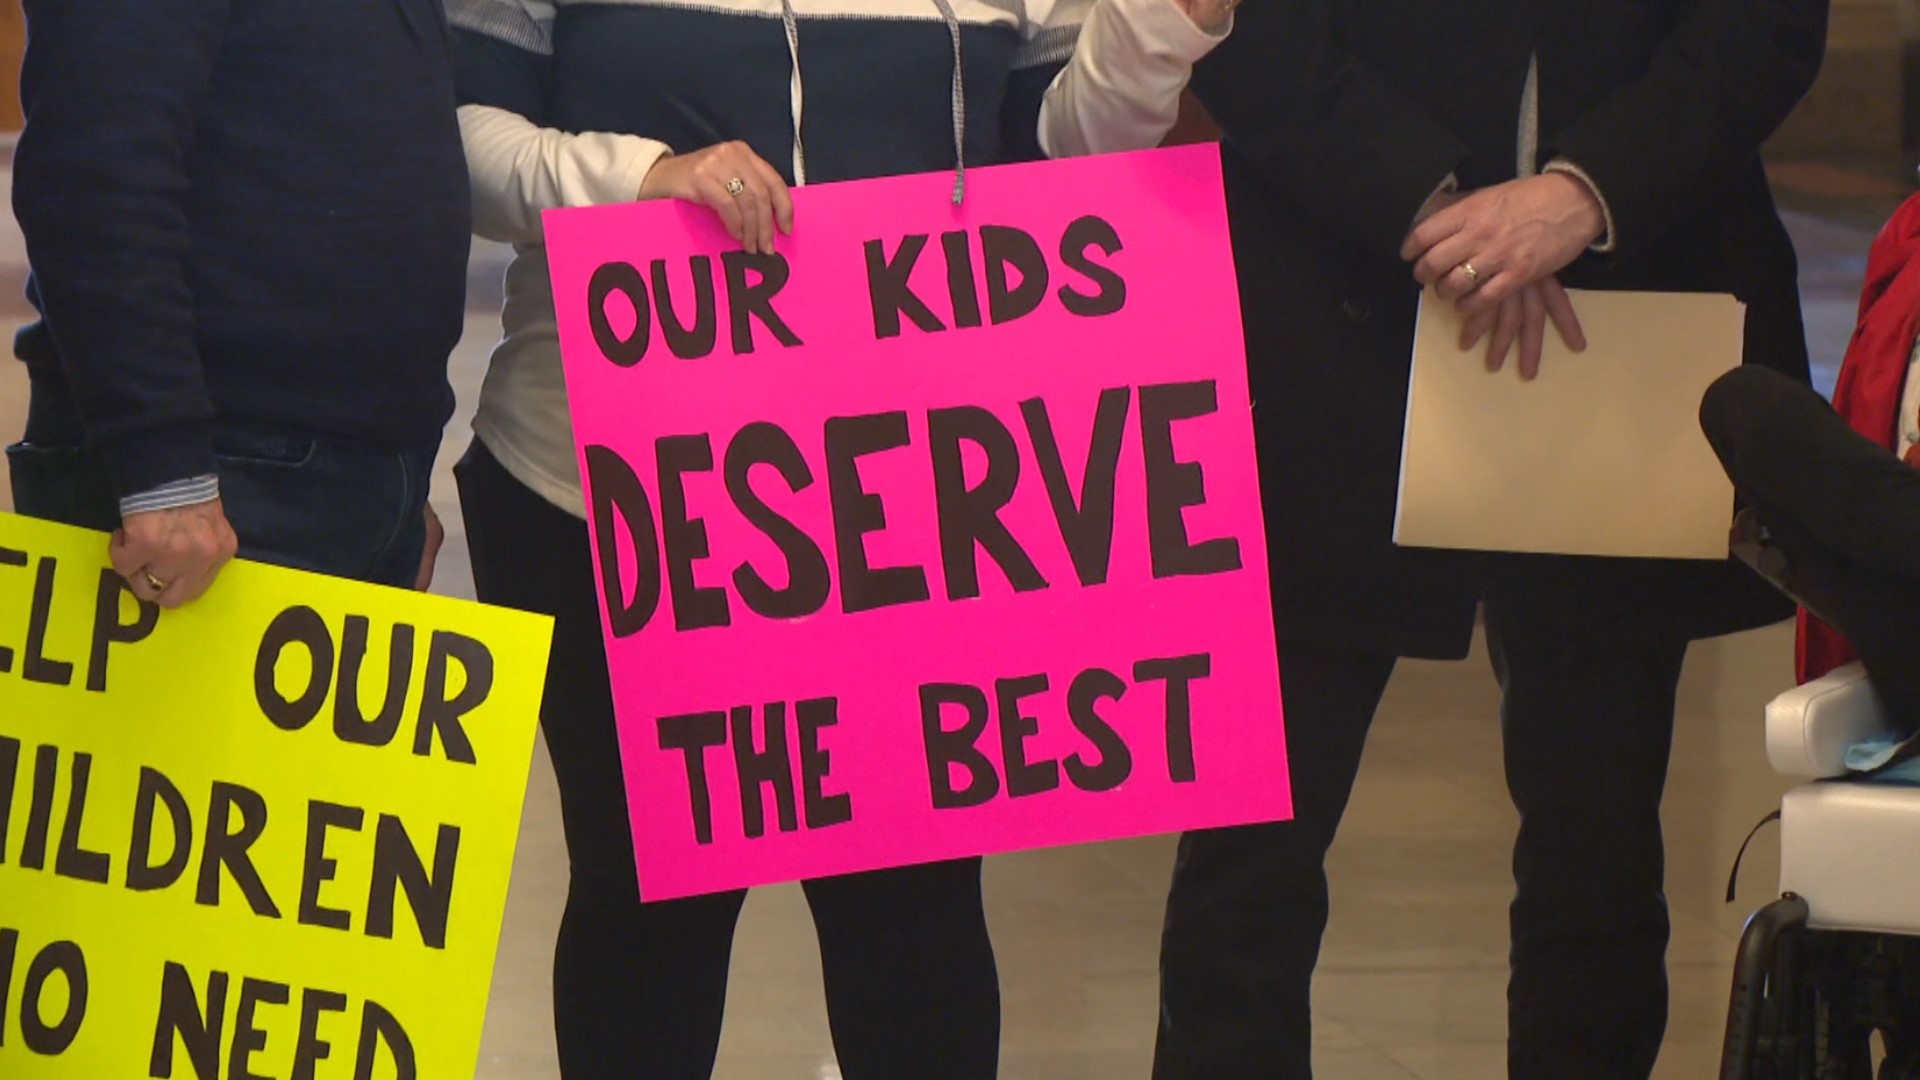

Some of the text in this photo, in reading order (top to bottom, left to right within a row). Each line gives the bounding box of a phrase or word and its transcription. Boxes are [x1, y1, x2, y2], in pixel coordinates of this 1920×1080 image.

[587, 215, 1127, 367] OUR KIDS
[585, 379, 1243, 639] DESERVE
[254, 605, 494, 765] OUR
[656, 652, 1211, 846] THE BEST
[148, 960, 417, 1080] NEED
